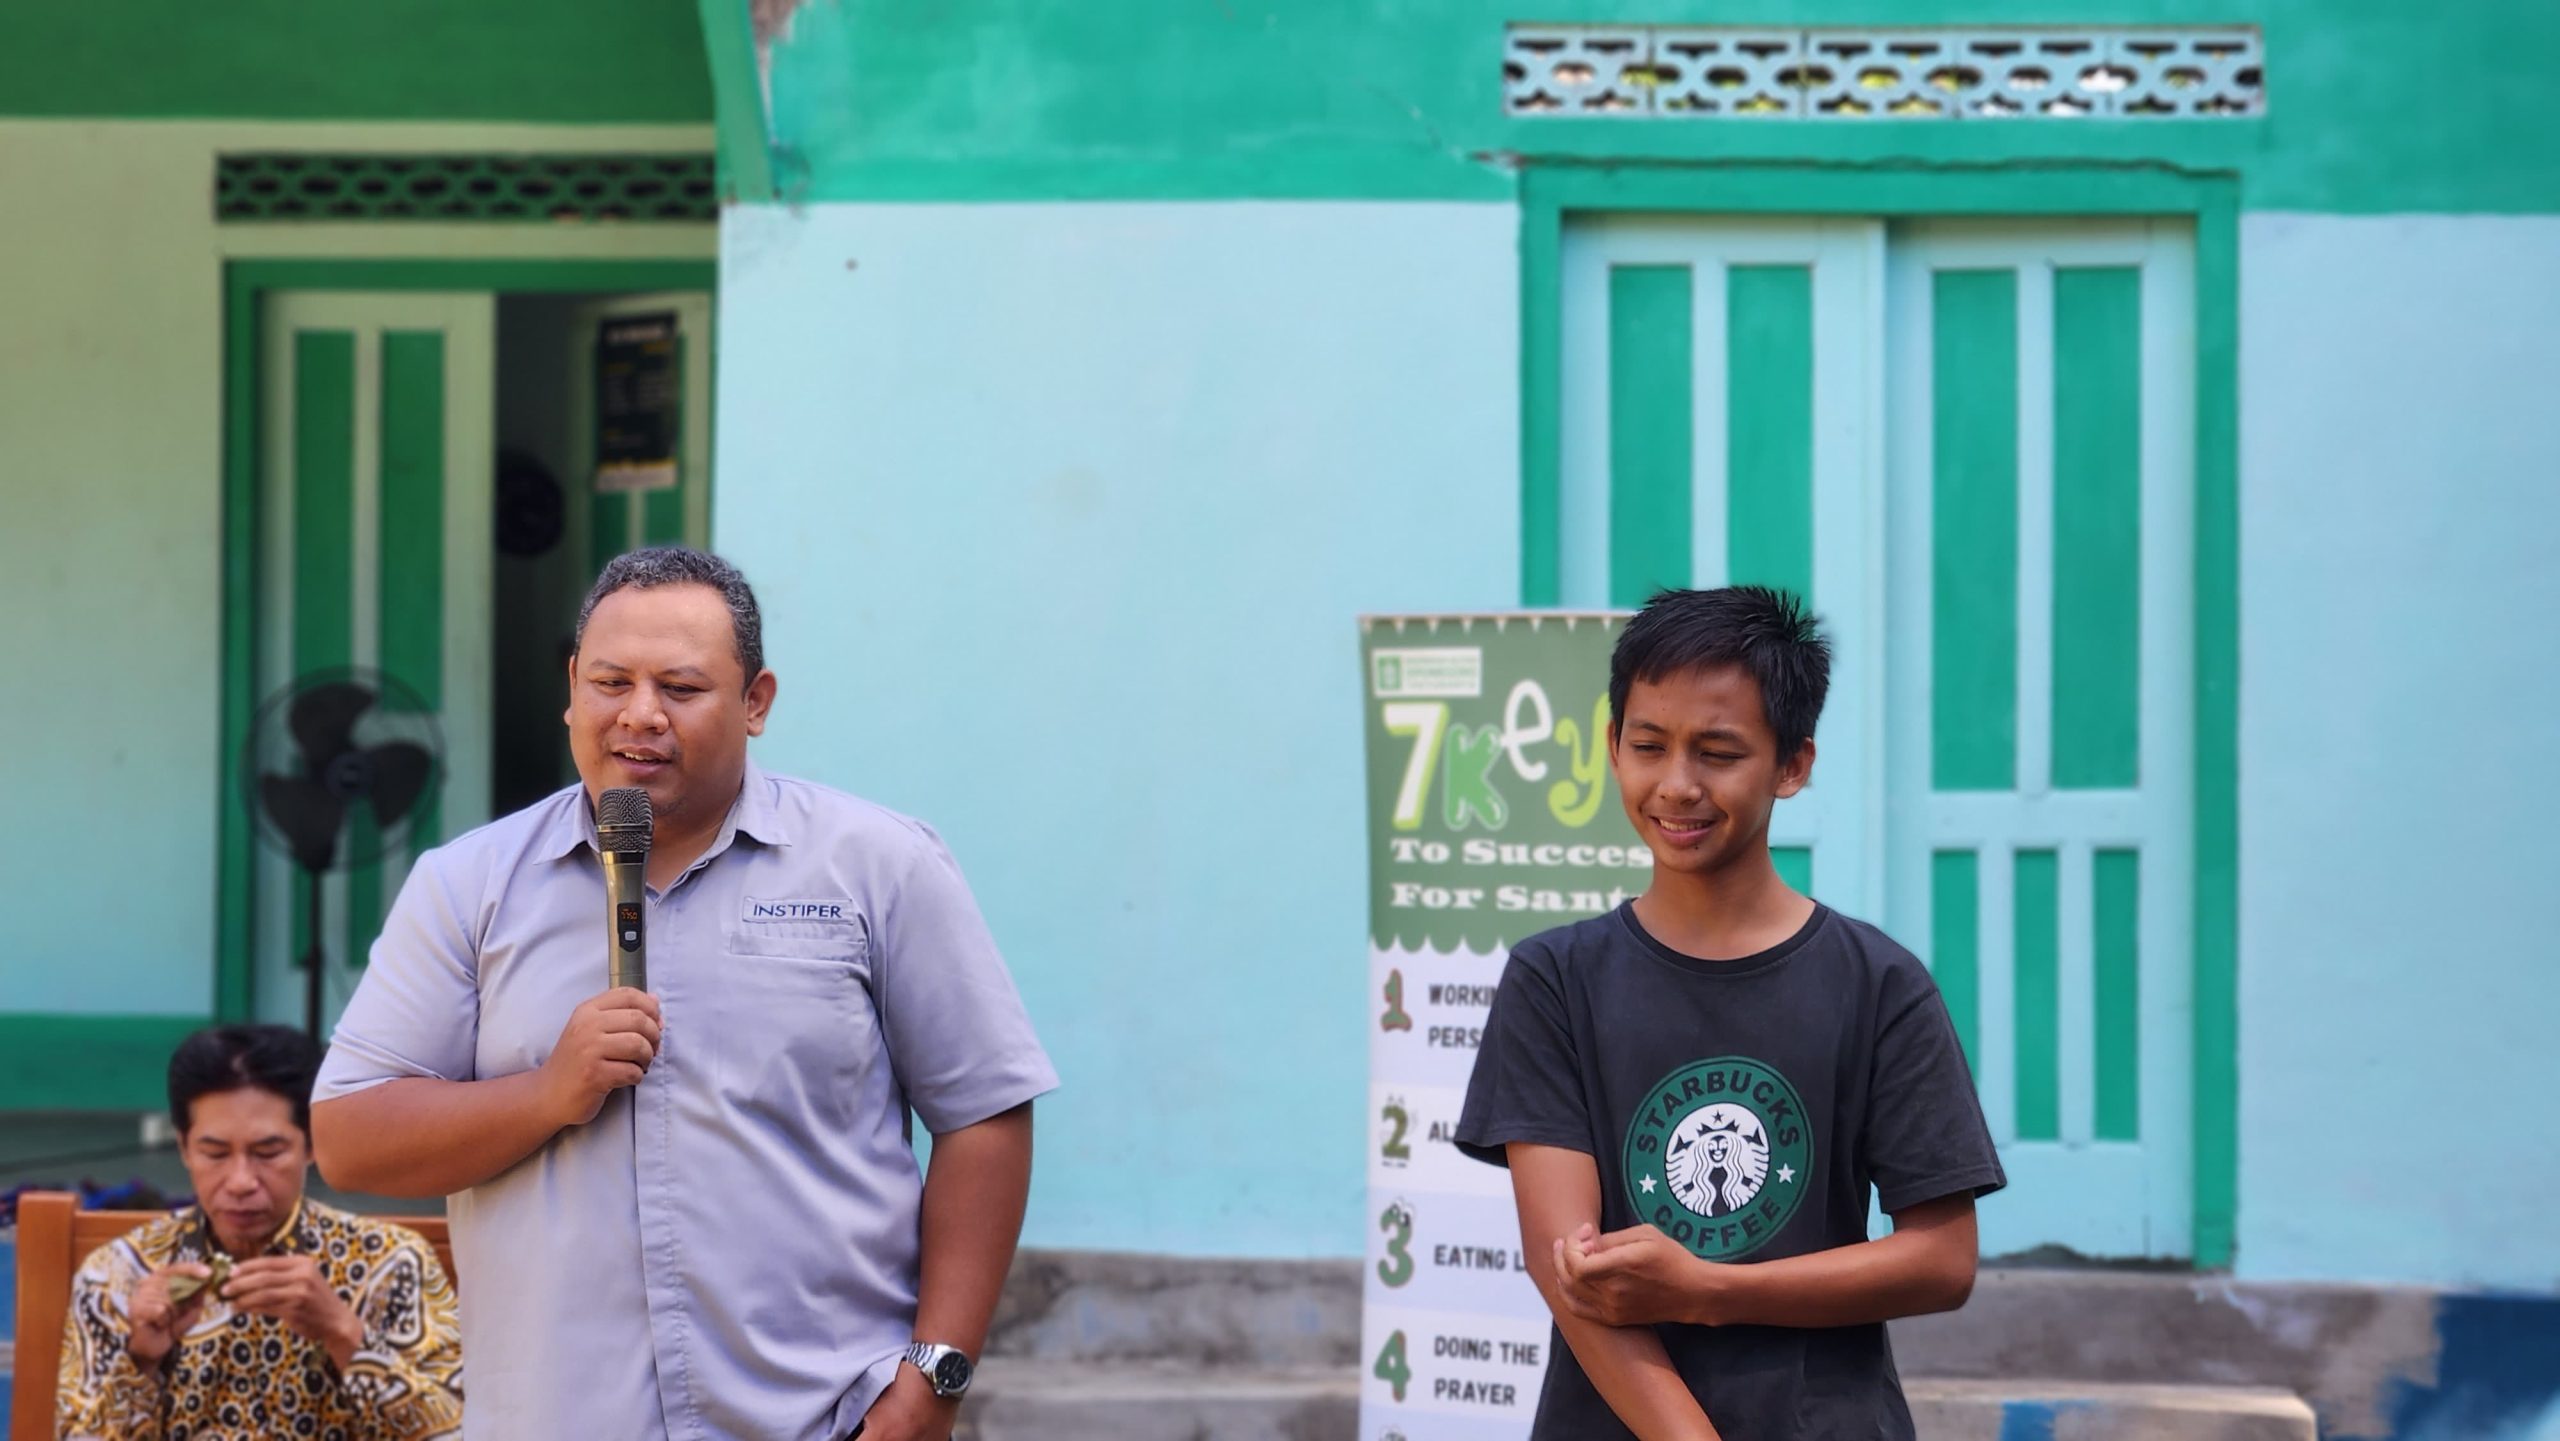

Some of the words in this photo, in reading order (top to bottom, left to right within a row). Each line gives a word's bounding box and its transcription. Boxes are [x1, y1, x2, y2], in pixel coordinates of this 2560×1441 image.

[1391, 838, 1450, 863] To
[1462, 839, 1654, 868] Succes
[753, 904, 842, 918] INSTIPER
[1391, 883, 1484, 909] For
[1496, 885, 1642, 912] Sant
[1382, 1105, 1410, 1159] 2
[1636, 1070, 1800, 1154] STARBUCKS
[1653, 1197, 1781, 1248] COFFEE
[1378, 1203, 1414, 1288] 3
[1434, 1244, 1507, 1271] EATING
[1374, 1329, 1412, 1402] 4
[1434, 1336, 1491, 1361] DOING
[1499, 1342, 1540, 1366] THE
[1434, 1377, 1516, 1406] PRAYER
